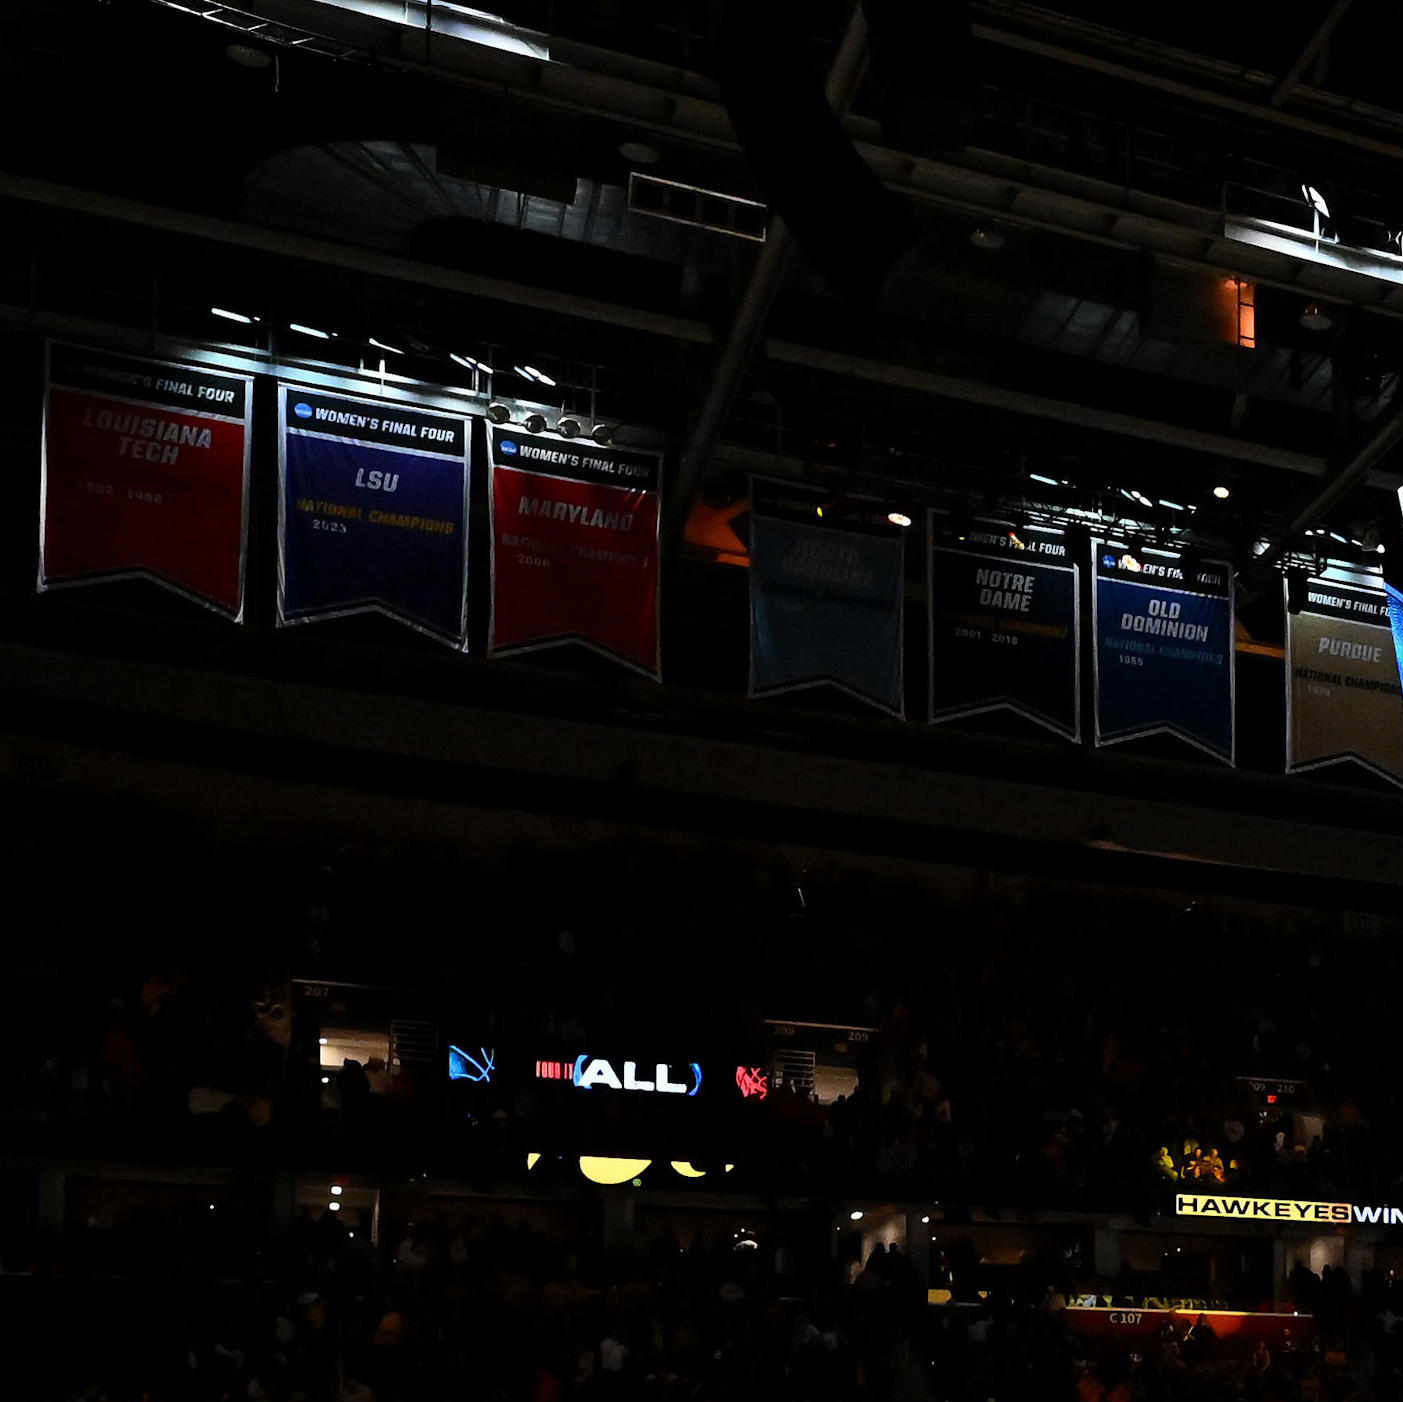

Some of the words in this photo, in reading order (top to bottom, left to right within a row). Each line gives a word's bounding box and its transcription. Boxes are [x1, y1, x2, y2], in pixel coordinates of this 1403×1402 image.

[156, 379, 194, 396] FINAL
[197, 385, 235, 404] FOUR
[81, 406, 213, 450] LOUISIANA
[315, 407, 379, 432] WOMEN'S
[382, 418, 417, 440] FINAL
[419, 426, 455, 443] FOUR
[118, 434, 180, 466] TECH
[519, 445, 579, 467] WOMEN'S
[582, 455, 615, 473] FINAL
[618, 462, 650, 480] FOUR
[356, 467, 400, 493] LSU
[298, 498, 362, 520] NATIONAL
[368, 510, 454, 536] CHAMPIONS
[312, 519, 348, 535] 2023
[518, 495, 634, 533] MARYLAND
[1039, 541, 1066, 556] FOUR
[975, 567, 1036, 594] NOTRE
[979, 590, 1033, 614] DAME
[1149, 598, 1181, 620] OLD
[1307, 591, 1351, 611] WOMEN'S
[1353, 600, 1383, 615] FINAL
[1120, 612, 1209, 643] DOMINION
[1318, 637, 1383, 663] PURDUE
[1295, 667, 1341, 687] NATIONAL
[1344, 675, 1401, 696] CHAMPION
[577, 1058, 688, 1095] ALL
[1179, 1197, 1349, 1222] HAWKEYES
[1109, 1313, 1119, 1324] C
[1121, 1313, 1142, 1325] 107
